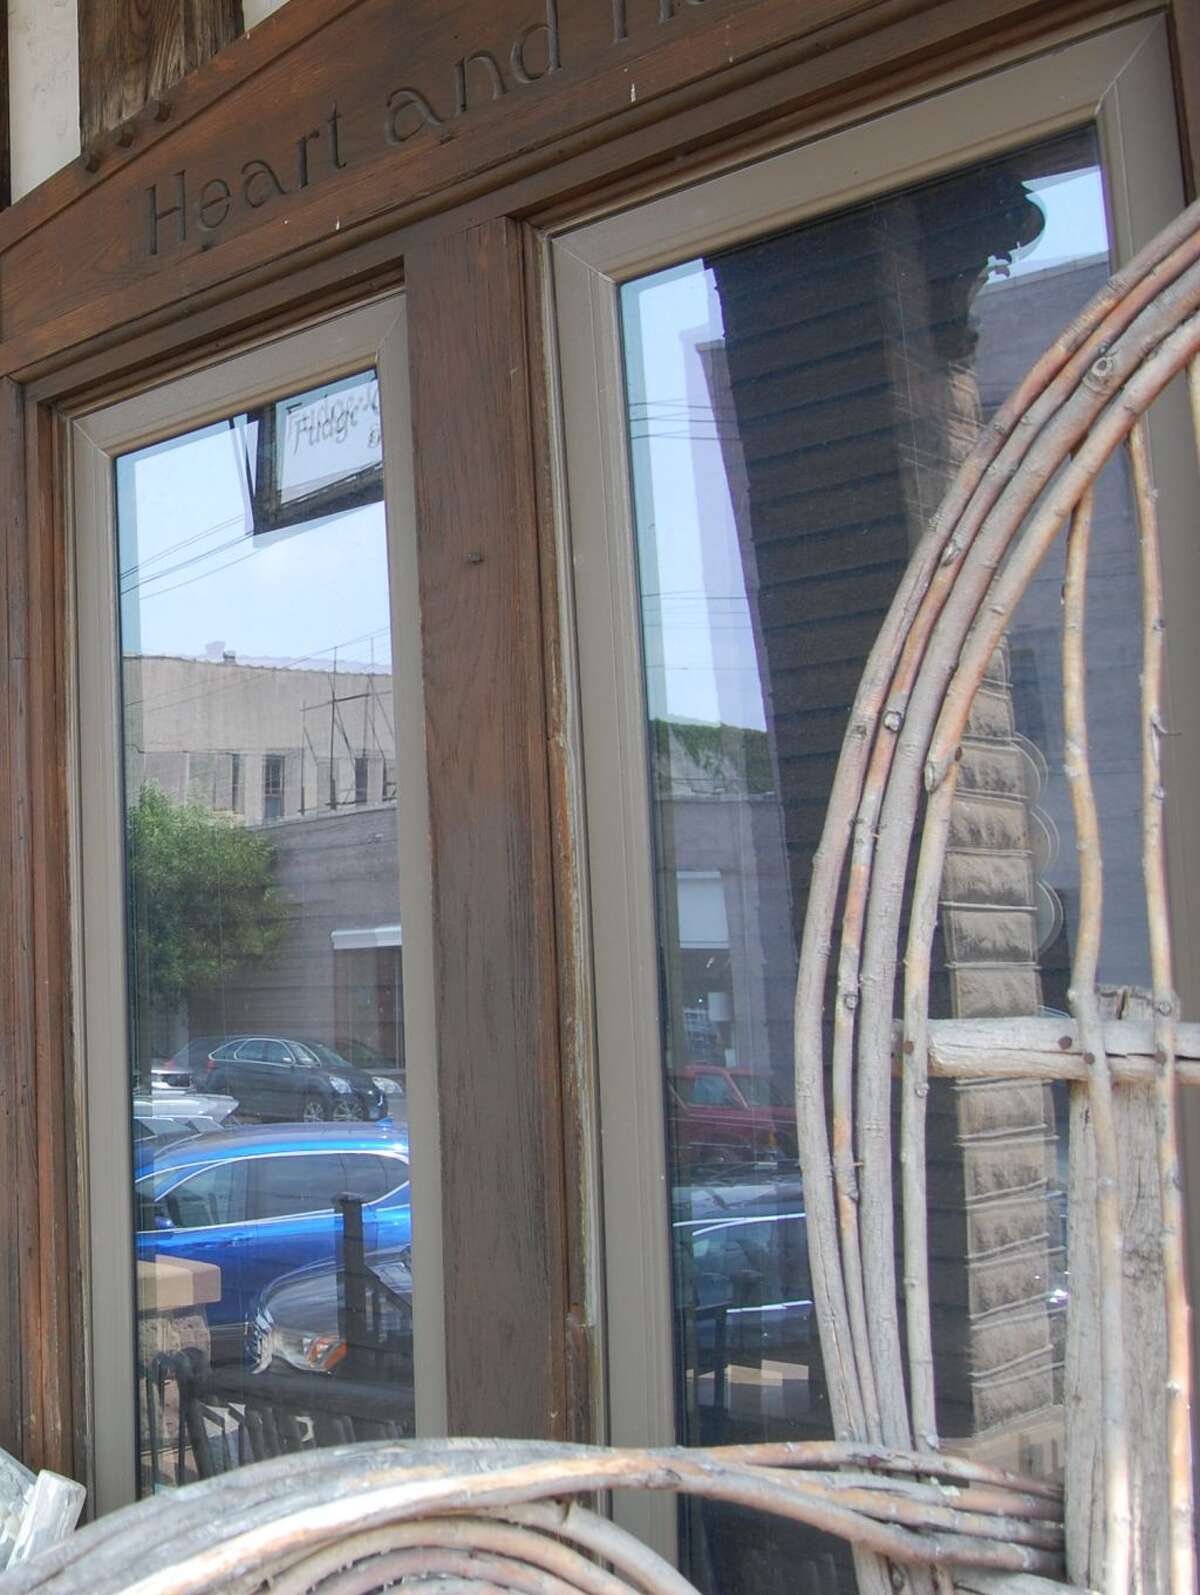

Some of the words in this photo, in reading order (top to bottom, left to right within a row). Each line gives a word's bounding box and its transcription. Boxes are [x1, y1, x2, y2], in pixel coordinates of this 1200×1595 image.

[145, 100, 349, 257] Heart
[384, 0, 566, 147] and
[293, 404, 359, 456] Fudge
